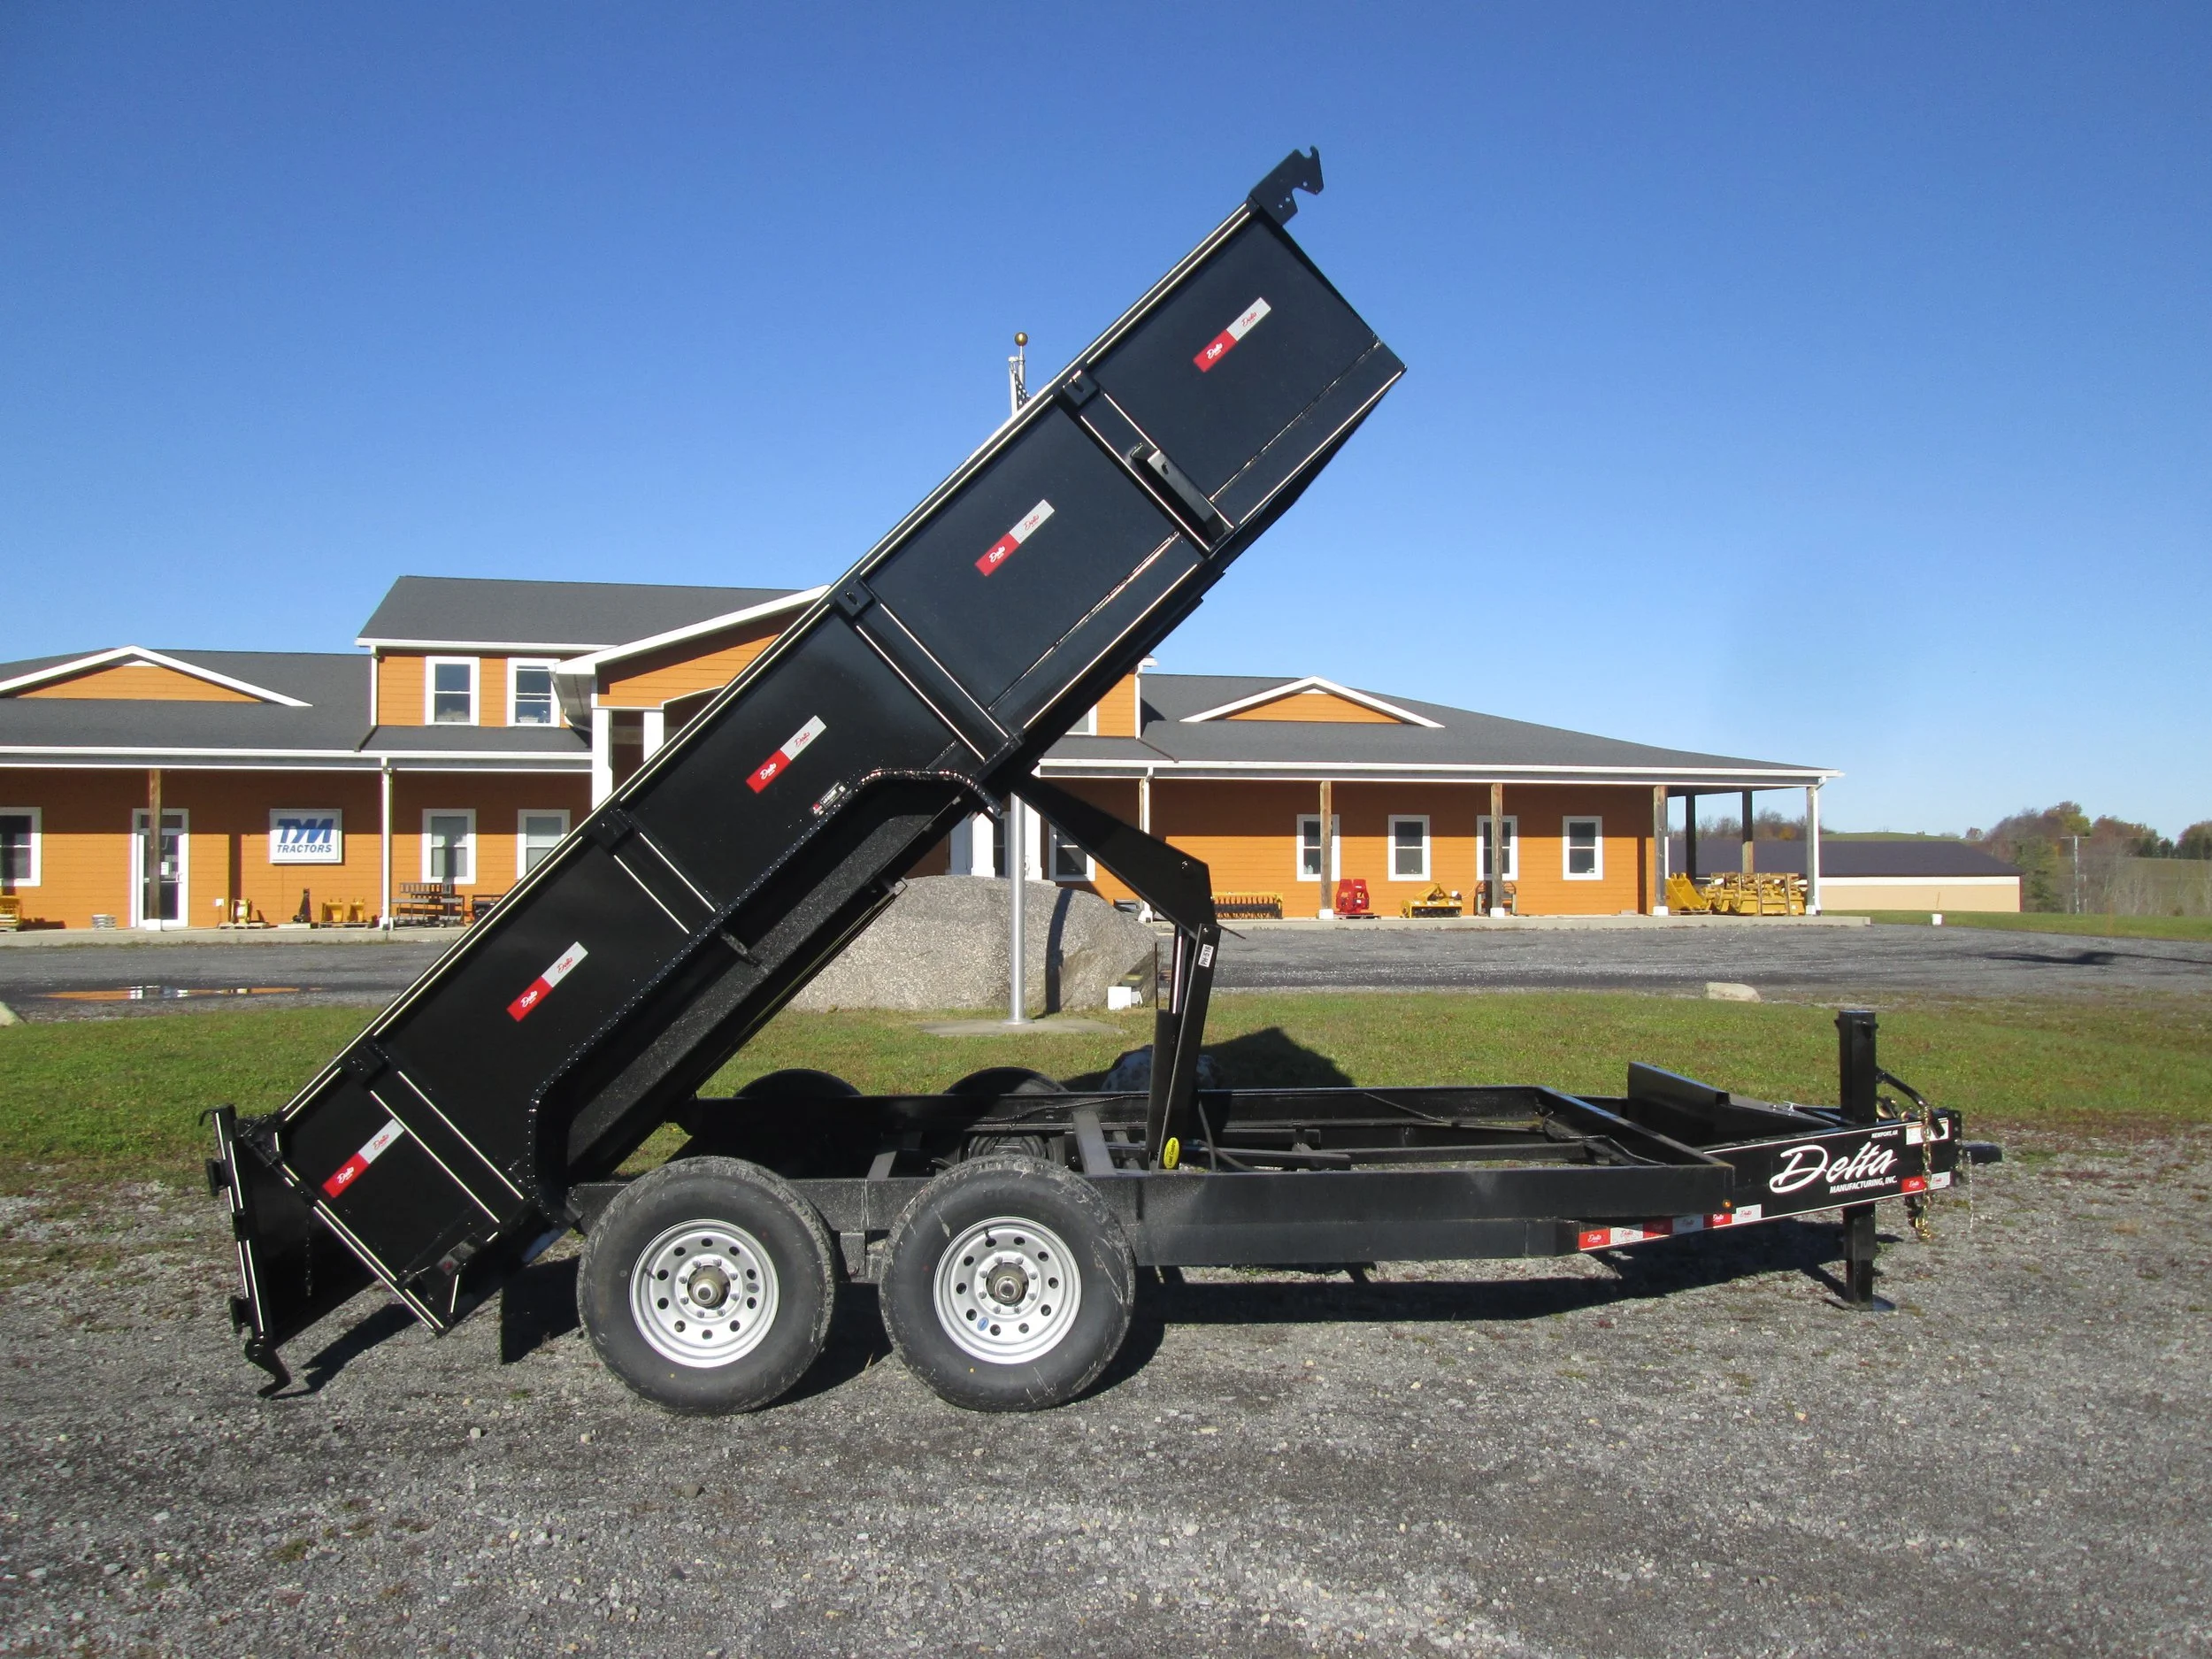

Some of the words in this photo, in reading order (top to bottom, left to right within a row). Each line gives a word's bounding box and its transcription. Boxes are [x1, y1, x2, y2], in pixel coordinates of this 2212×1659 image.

[277, 818, 334, 843] TYM
[277, 844, 332, 853] TRACTORS
[1770, 1141, 1897, 1193] Delta
[1829, 1177, 1885, 1194] MANUFACTURING,
[1885, 1175, 1897, 1185] INC.
